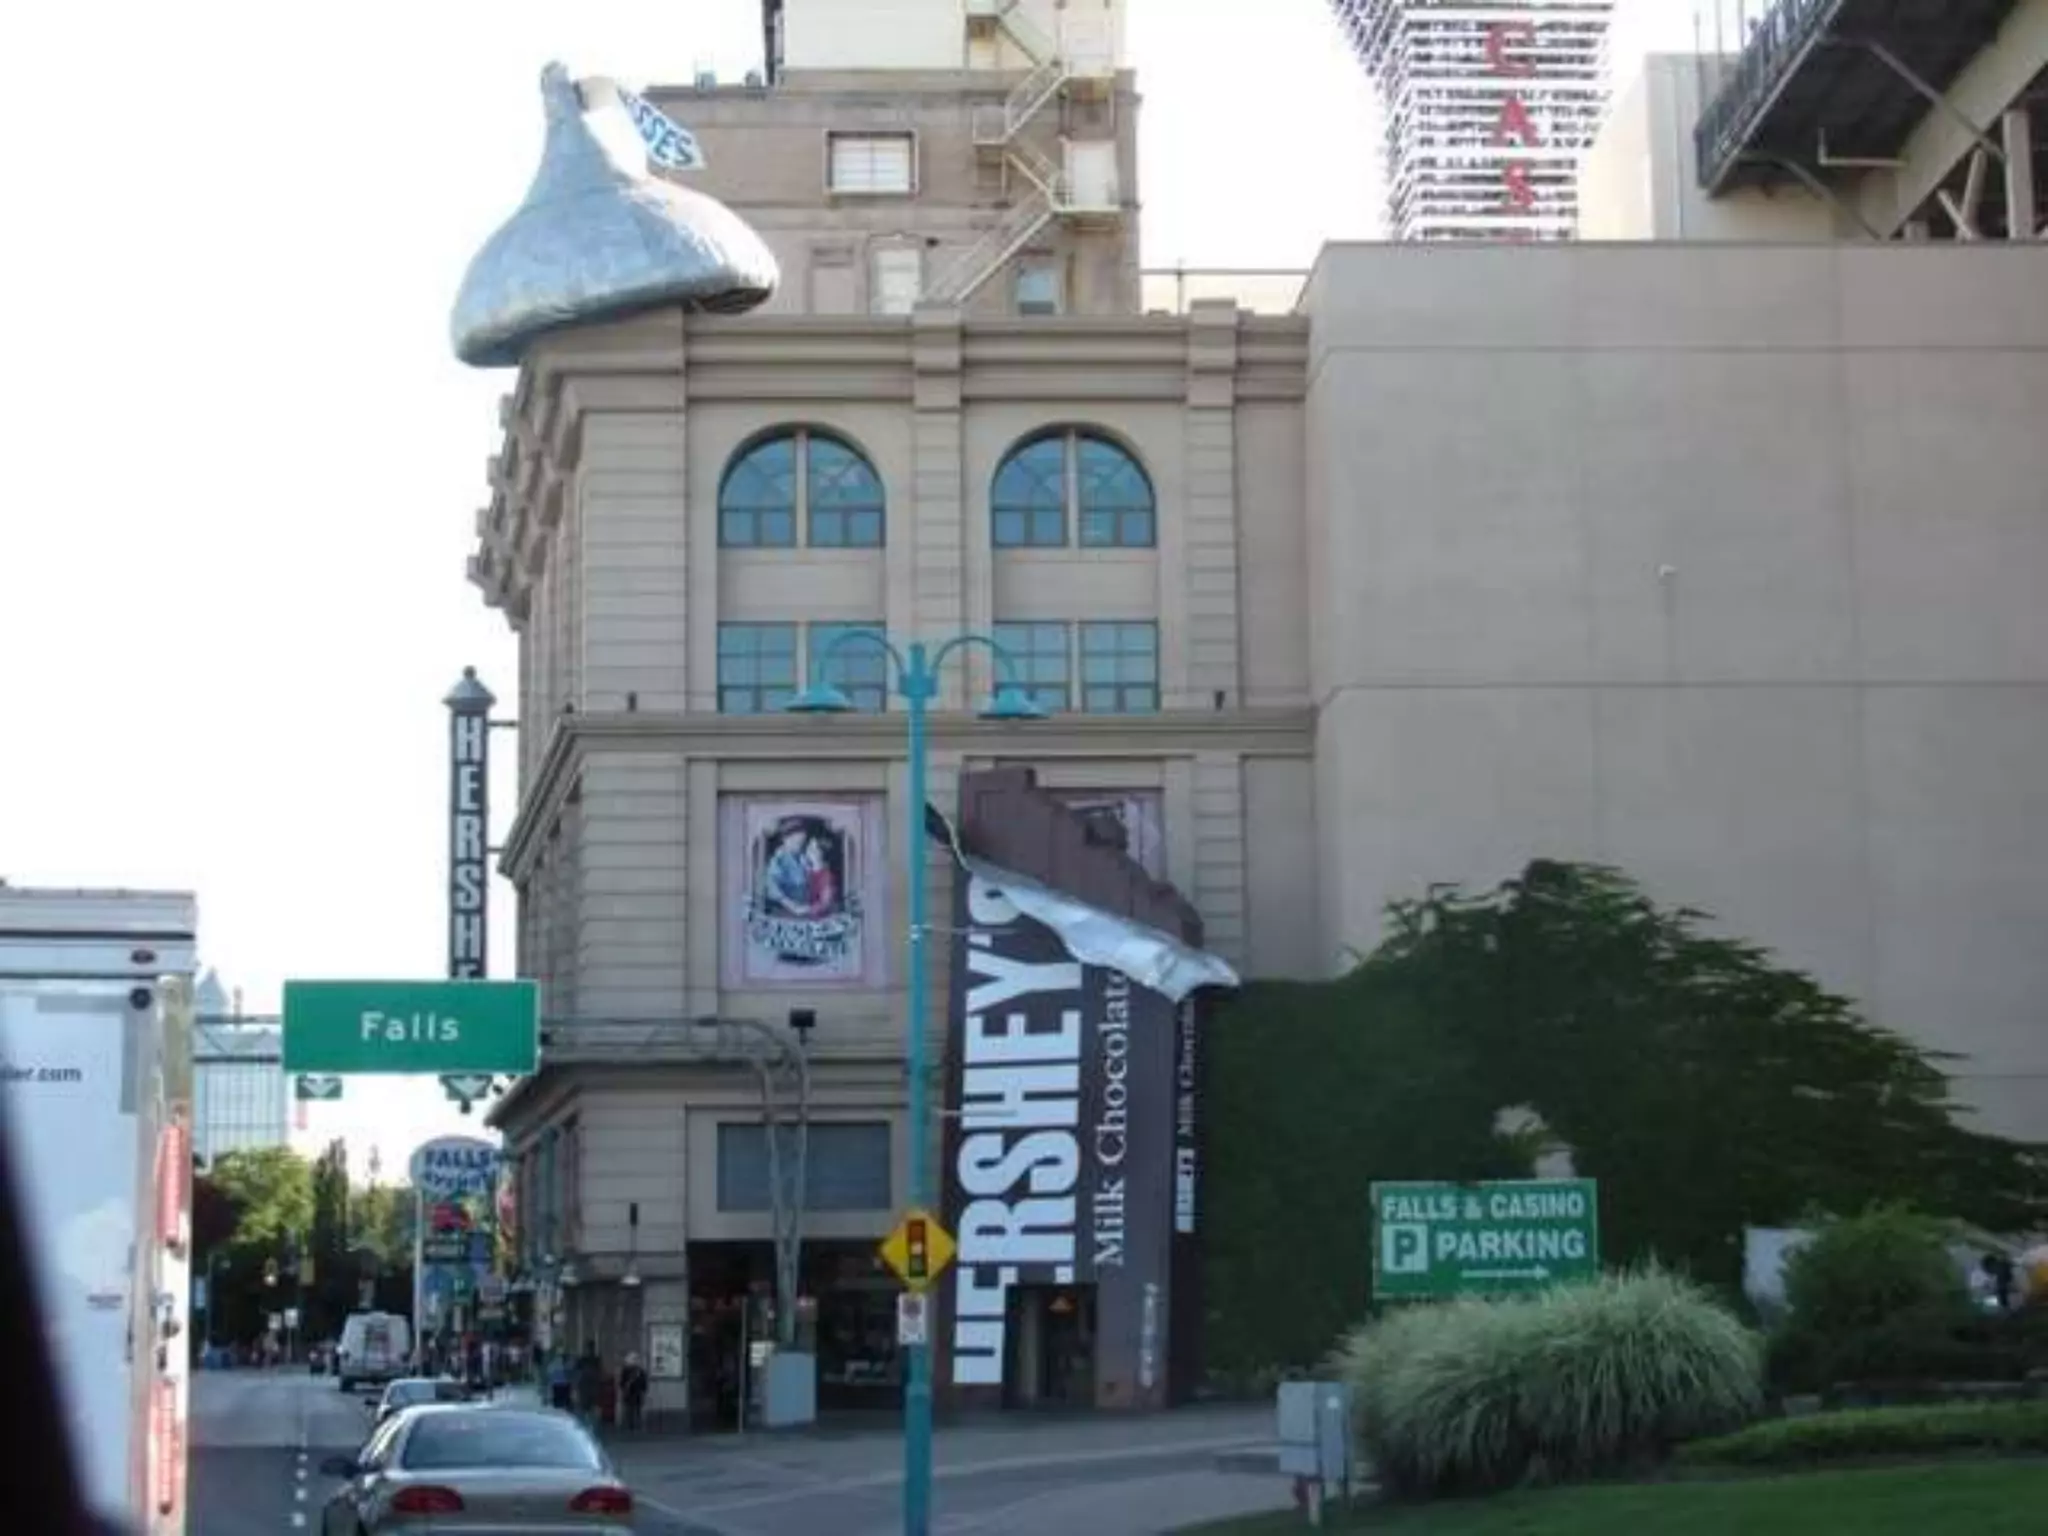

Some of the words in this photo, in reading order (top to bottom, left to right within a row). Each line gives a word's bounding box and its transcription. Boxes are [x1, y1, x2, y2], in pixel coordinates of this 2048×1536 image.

[361, 1010, 459, 1041] Falls
[1093, 1176, 1127, 1267] Milk
[1381, 1195, 1457, 1220] FALLS
[1463, 1196, 1483, 1220] &
[1489, 1191, 1586, 1220] CASINO
[1392, 1228, 1419, 1268] P
[1435, 1228, 1586, 1261] PARKING
